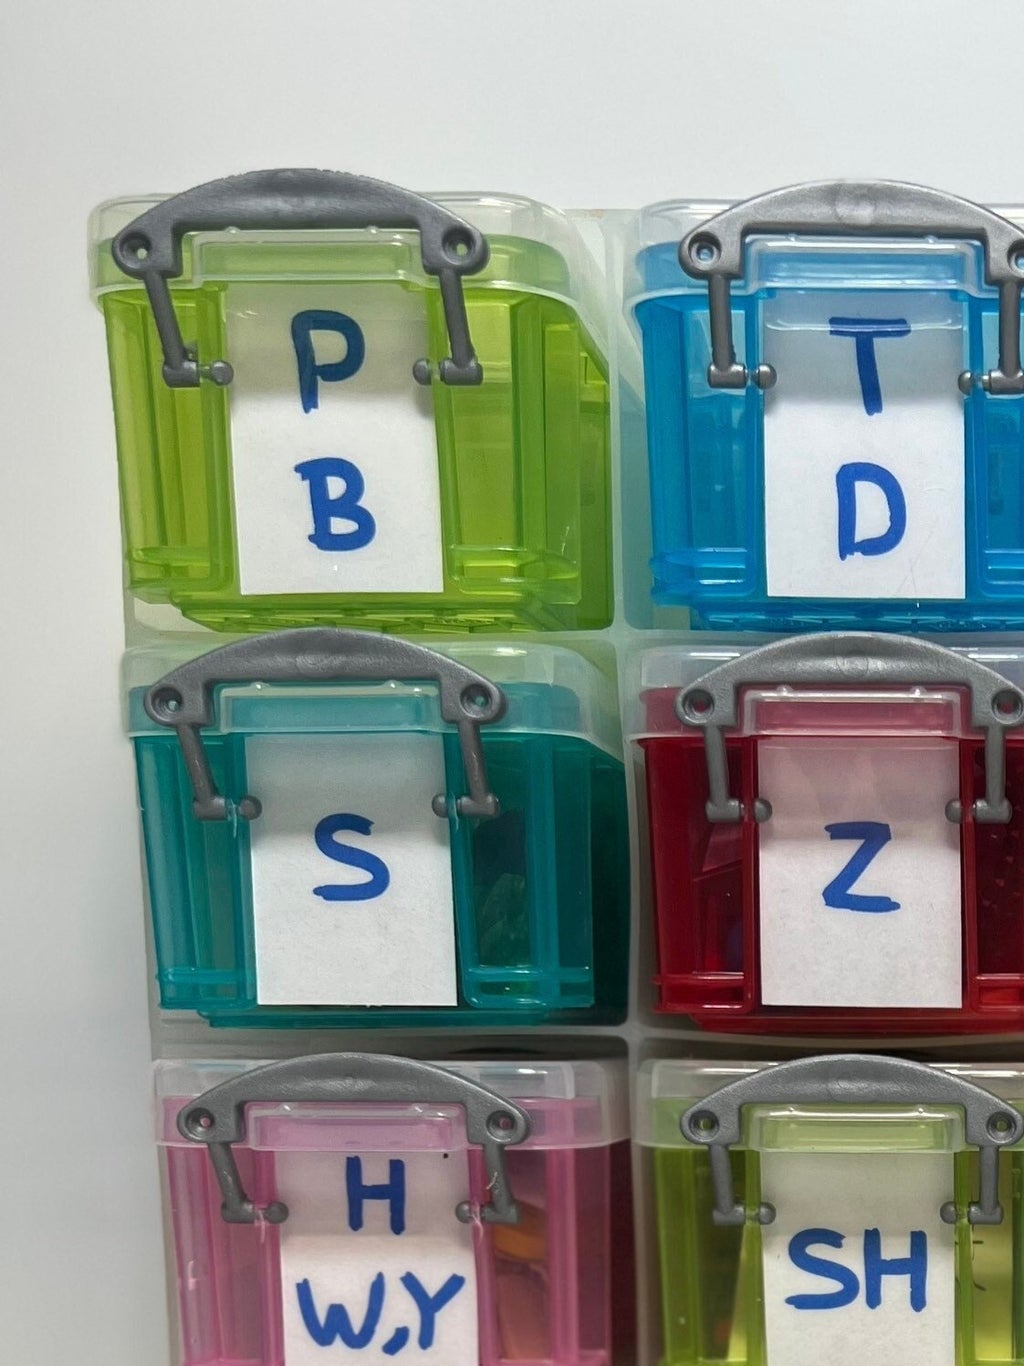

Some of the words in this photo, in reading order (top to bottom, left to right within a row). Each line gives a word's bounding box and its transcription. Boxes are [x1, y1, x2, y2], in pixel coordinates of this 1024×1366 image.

[290, 309, 364, 414] P
[829, 318, 909, 417] T
[293, 456, 376, 552] B
[836, 461, 907, 561] D
[312, 813, 391, 902] S
[821, 821, 901, 914] Z
[345, 1155, 405, 1236] H
[295, 1272, 466, 1357] W,Y
[785, 1228, 928, 1313] SH
